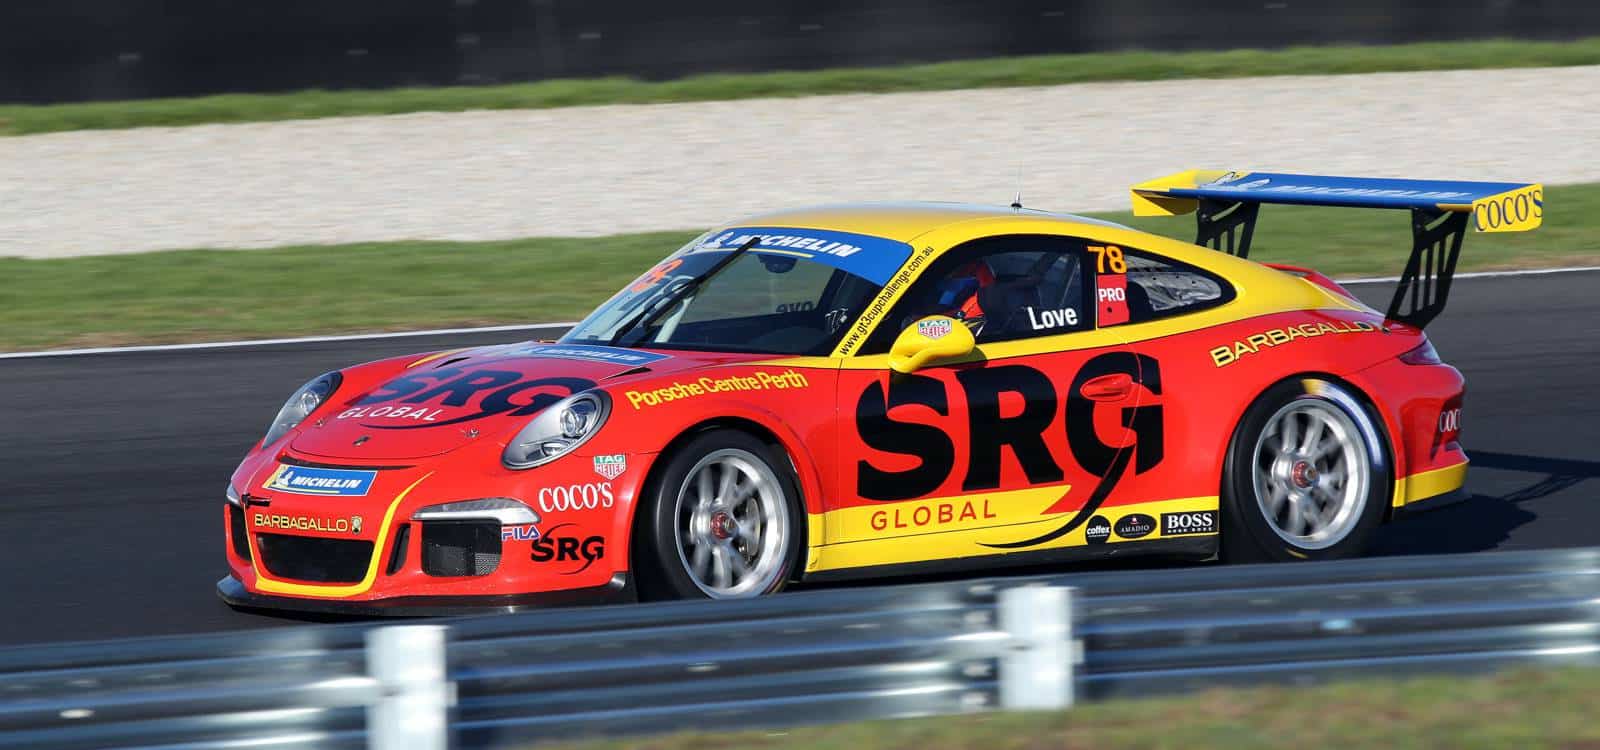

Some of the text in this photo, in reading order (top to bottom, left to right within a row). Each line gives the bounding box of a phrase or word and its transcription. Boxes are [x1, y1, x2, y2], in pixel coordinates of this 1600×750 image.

[1474, 190, 1543, 231] COCO'S
[1087, 245, 1127, 274] 78
[840, 246, 934, 355] www.gt3cupchallenge.com.au
[1098, 287, 1125, 302] PRO
[1027, 306, 1078, 330] Love
[1210, 321, 1374, 368] BARBAGALLO
[344, 368, 601, 417] SRG
[626, 369, 808, 409] Porsche Centre Perth
[337, 406, 443, 421] GLOBAL
[855, 352, 1164, 501] SRG
[596, 455, 625, 464] TAG
[596, 463, 625, 477] HEUER
[291, 476, 362, 488] MICHELIN
[539, 482, 613, 512] COCO'S
[254, 513, 348, 532] BARBAGALLO
[871, 499, 997, 531] GLOBAL
[1167, 512, 1213, 529] BOSS
[501, 525, 541, 542] FILA
[531, 536, 604, 562] SRG
